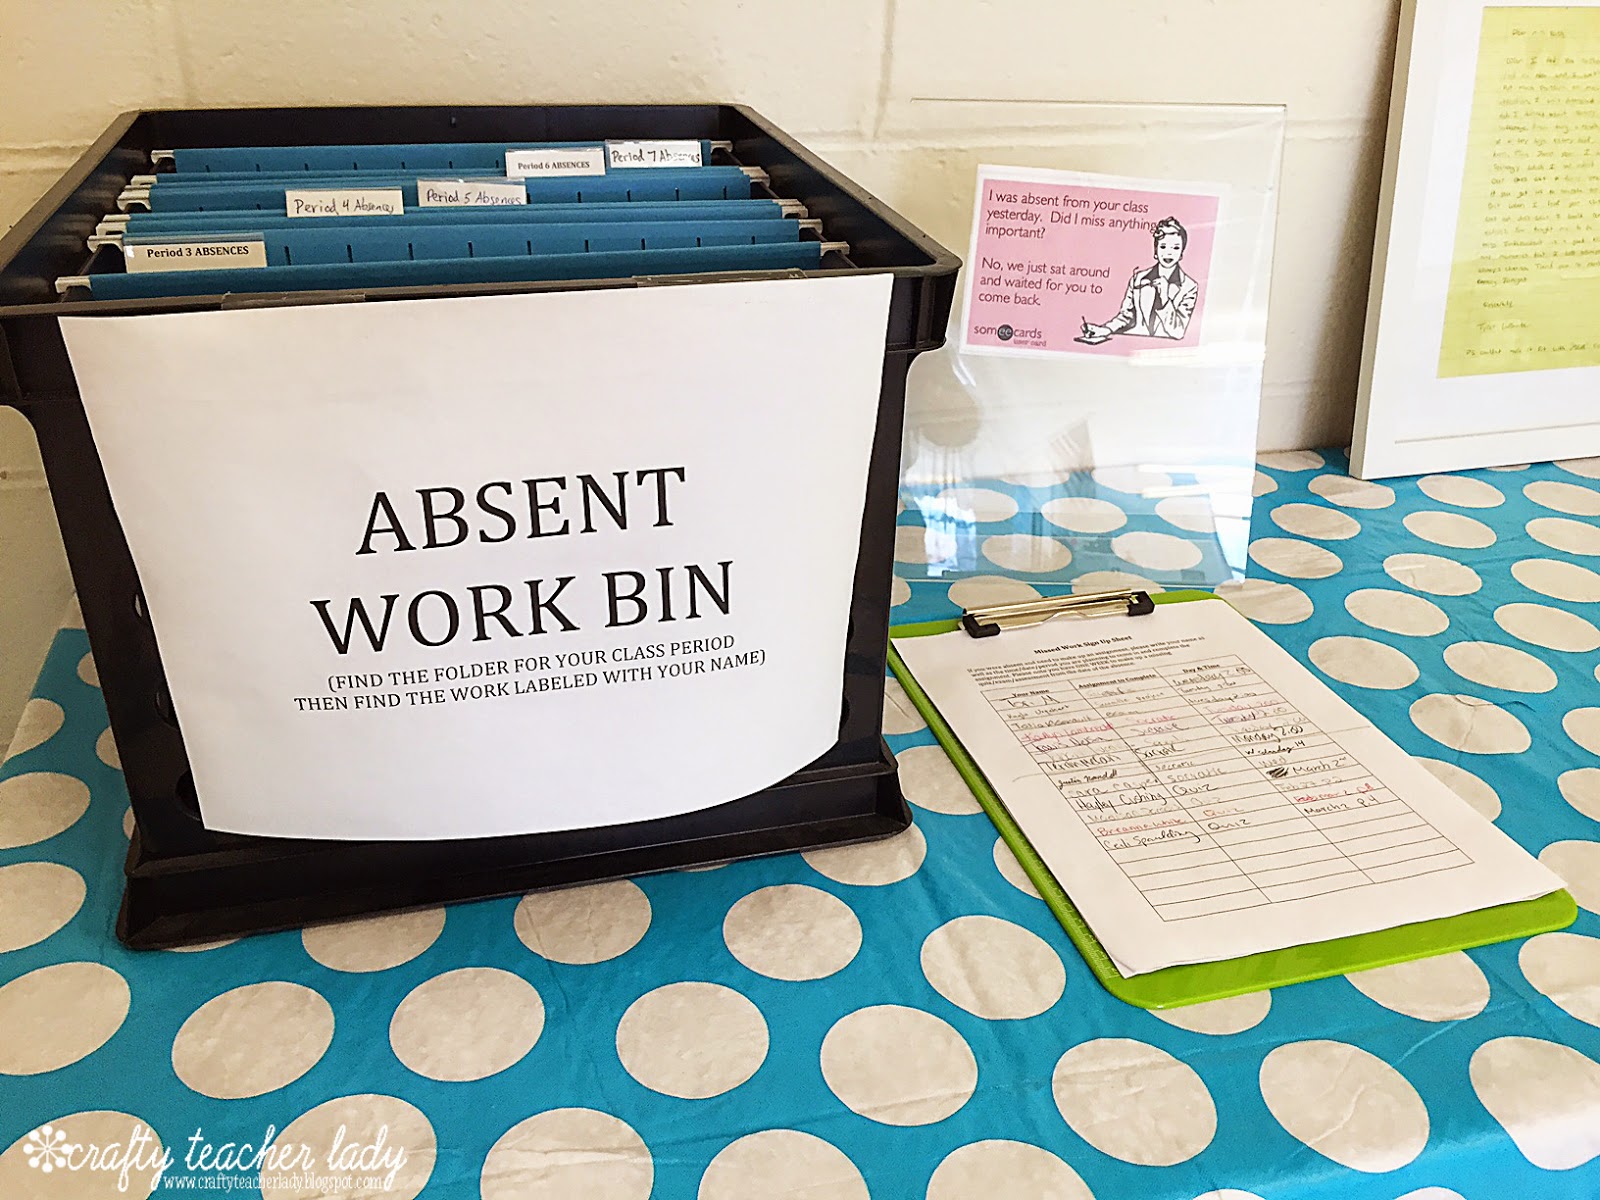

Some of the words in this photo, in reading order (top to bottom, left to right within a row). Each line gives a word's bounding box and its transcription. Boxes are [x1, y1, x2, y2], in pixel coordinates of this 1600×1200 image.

[611, 147, 645, 163] Period
[648, 149, 656, 162] 7
[517, 161, 544, 171] Period
[552, 160, 590, 169] ABSENCES
[426, 189, 461, 203] Period
[465, 192, 471, 202] 5
[988, 190, 993, 201] I
[995, 194, 1018, 203] was
[1021, 193, 1060, 207] absent
[1063, 195, 1090, 208] from
[1093, 200, 1120, 213] your
[1123, 201, 1148, 213] class
[294, 199, 337, 214] Period
[342, 199, 349, 209] 4
[986, 208, 1042, 222] yesterday.
[1050, 211, 1072, 224] Did
[1074, 213, 1078, 225] I
[1081, 215, 1105, 227] miss
[1109, 218, 1158, 233] anything
[985, 225, 1046, 240] important?
[147, 246, 184, 259] Period
[185, 247, 192, 256] 3
[195, 244, 249, 257] ABSENCES
[981, 257, 1004, 272] No,
[1007, 263, 1023, 272] we
[1027, 262, 1047, 275] just
[1050, 264, 1066, 275] sat
[1069, 264, 1110, 279] around
[980, 276, 1002, 287] and
[1005, 276, 1042, 290] waited
[1046, 279, 1063, 291] for
[1065, 283, 1087, 295] you
[1090, 283, 1102, 294] to
[978, 294, 1010, 304] come
[1014, 293, 1041, 306] back.
[974, 324, 1042, 341] someecards
[355, 466, 687, 556] ABSENT
[309, 575, 582, 655] WORK
[601, 560, 735, 629] BIN
[1033, 646, 1061, 655] Missed
[1061, 643, 1083, 652] Work
[1083, 639, 1100, 648] Sign
[1111, 635, 1133, 643] Sheet
[328, 668, 383, 693] (FIND
[387, 667, 429, 687] THE
[434, 660, 510, 685] FOLDER
[514, 656, 551, 674] FOR
[555, 650, 607, 670] YOUR
[612, 643, 665, 663] CLASS
[669, 634, 736, 658] PERIOD
[293, 696, 348, 711] THEN
[354, 692, 403, 709] FIND
[408, 688, 447, 706] THE
[451, 682, 510, 702] WORK
[514, 672, 599, 696] LABELED
[602, 666, 653, 685] WITH
[656, 660, 708, 680] YOUR
[711, 648, 767, 673] NAME)
[1078, 679, 1121, 690] Assignment
[1125, 673, 1157, 683] Complete
[1293, 760, 1331, 775] March
[1172, 784, 1219, 796] Quiz
[1304, 803, 1341, 814] March
[1207, 819, 1250, 830] Quiz
